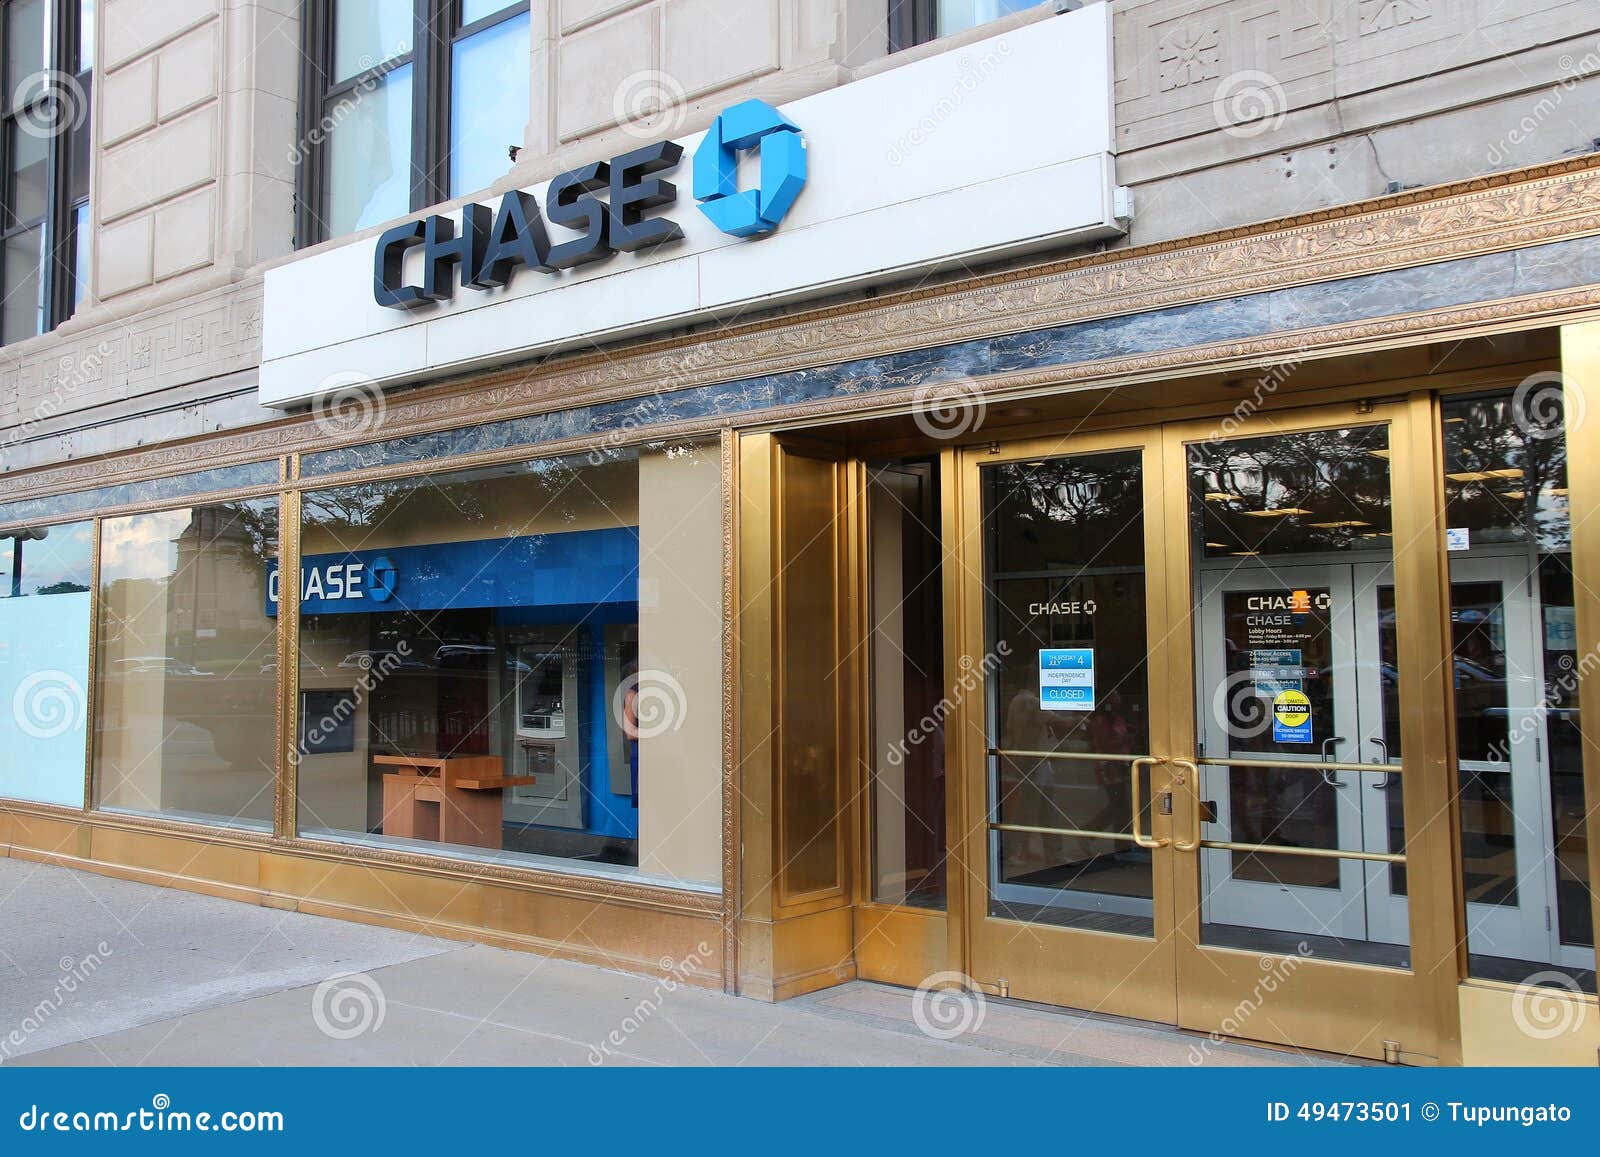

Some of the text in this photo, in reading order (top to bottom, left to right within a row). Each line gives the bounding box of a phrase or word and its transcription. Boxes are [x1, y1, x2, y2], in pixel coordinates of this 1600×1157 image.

[374, 140, 685, 311] CHASE
[269, 563, 364, 602] CASE
[1029, 601, 1081, 615] CHASE
[1247, 595, 1312, 610] CHASE
[1246, 615, 1292, 626] CHASE
[1077, 655, 1085, 665] 4
[1049, 689, 1085, 699] CLOSED
